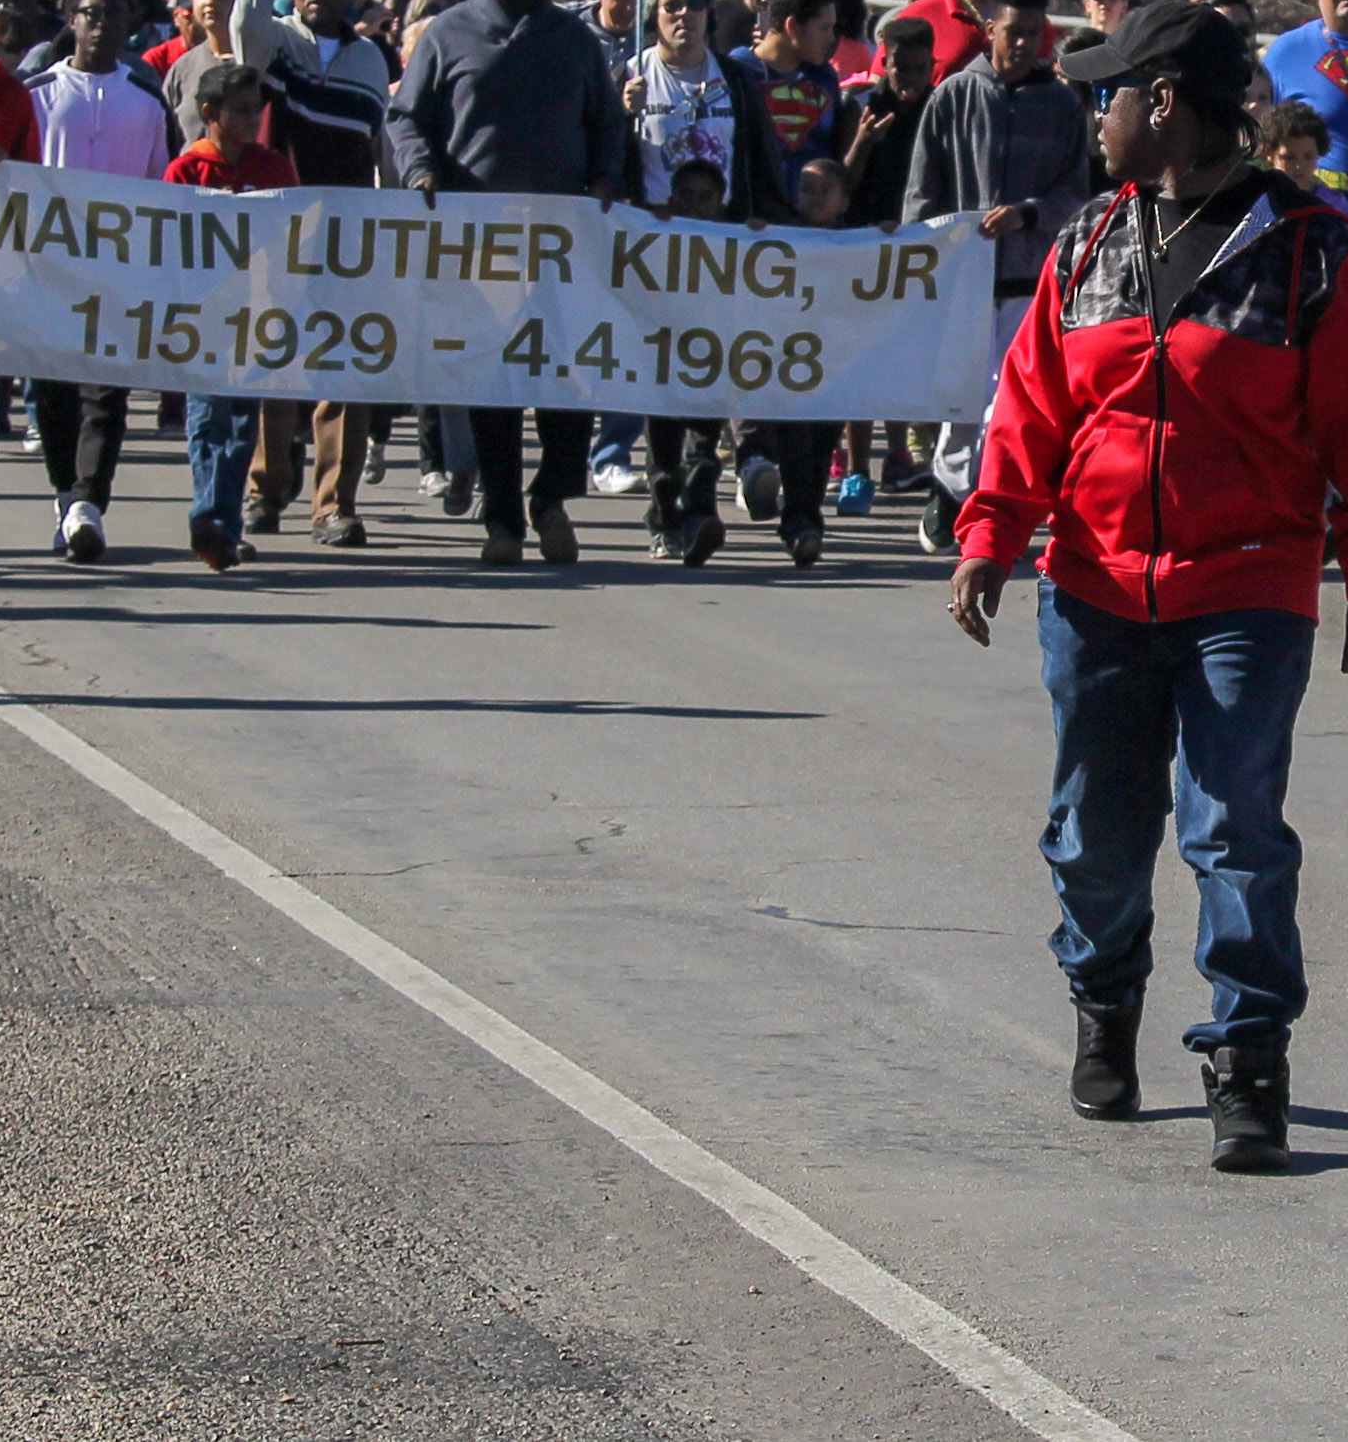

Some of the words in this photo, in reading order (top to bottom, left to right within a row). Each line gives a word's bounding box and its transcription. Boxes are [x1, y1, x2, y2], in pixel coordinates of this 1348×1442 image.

[286, 213, 573, 283] LUTHER
[610, 231, 816, 311] KING,
[851, 243, 940, 302] JR
[70, 294, 398, 375] 1.15.1929
[502, 317, 824, 393] 4.4.1968
